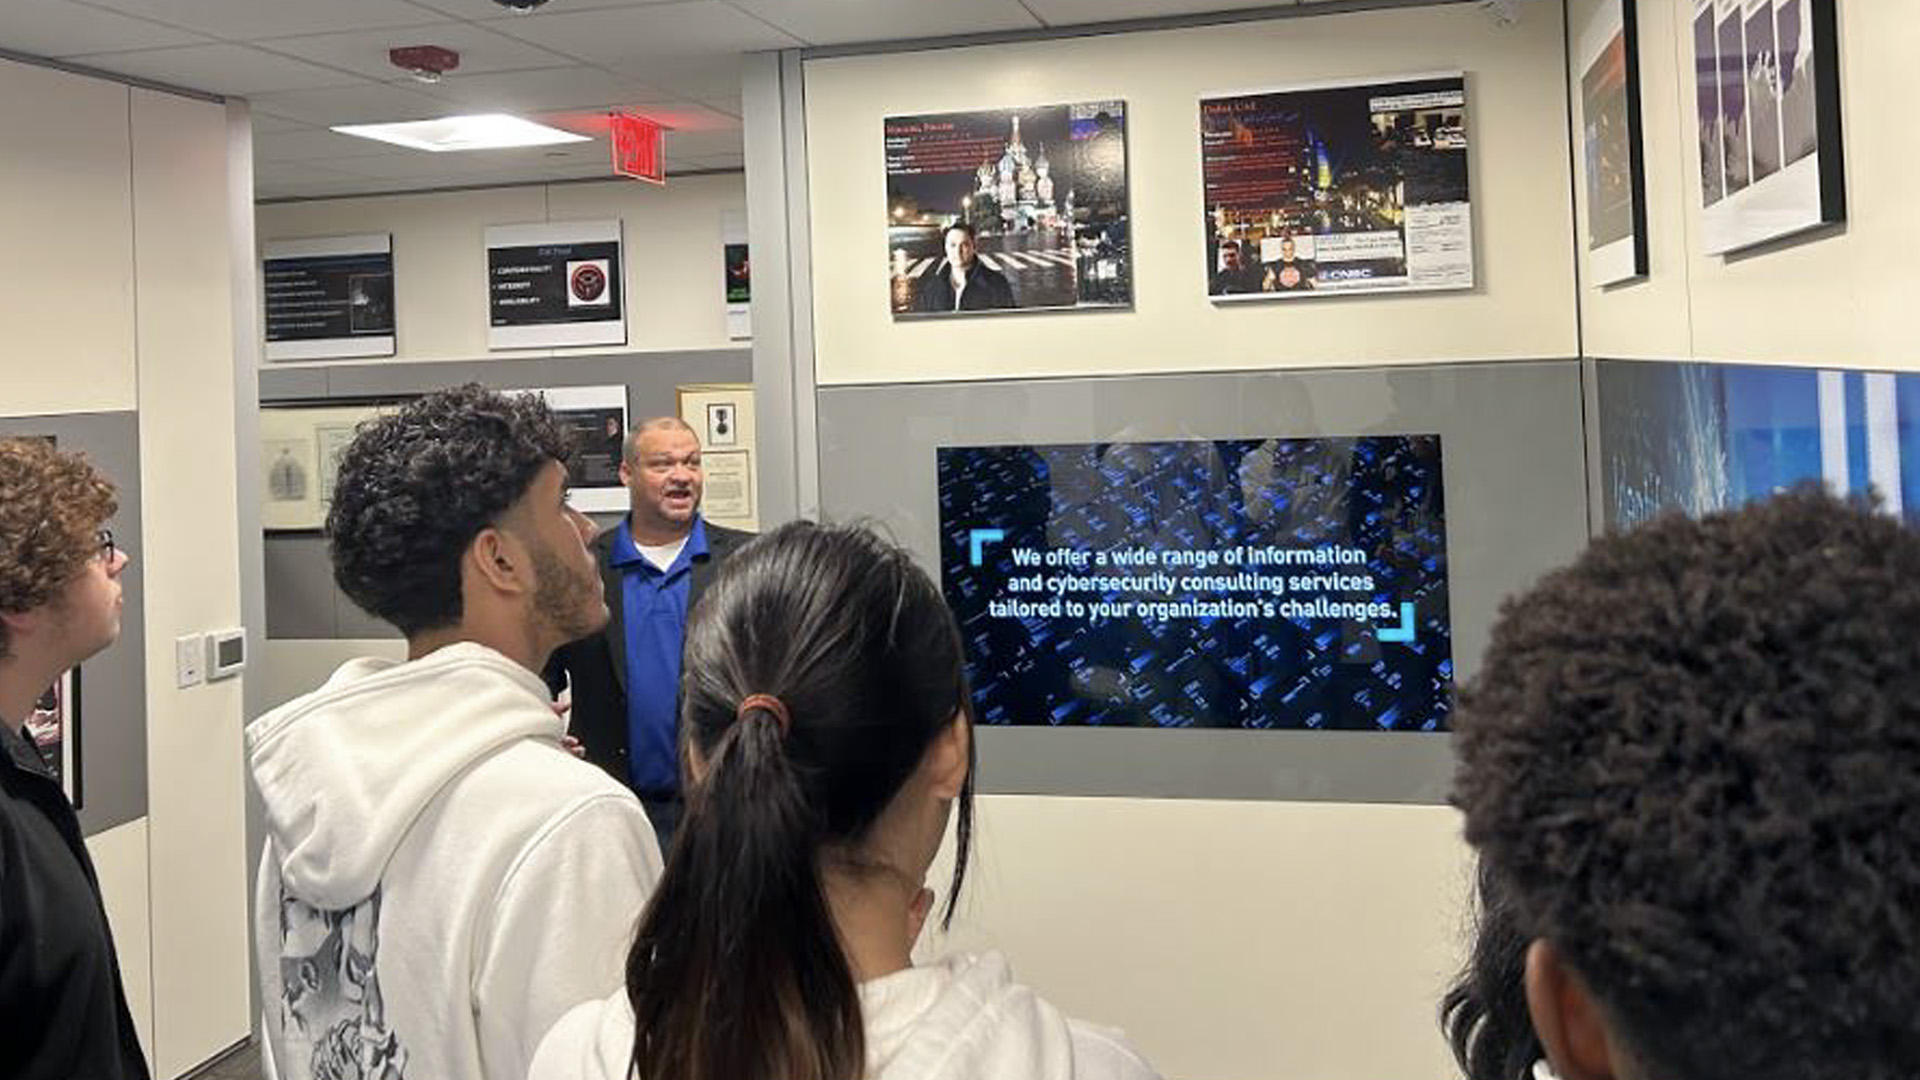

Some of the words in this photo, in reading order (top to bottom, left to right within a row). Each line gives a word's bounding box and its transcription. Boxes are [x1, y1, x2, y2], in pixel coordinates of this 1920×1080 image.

[1012, 548, 1041, 566] We
[1046, 548, 1091, 565] offer
[1095, 551, 1107, 565] a
[1111, 547, 1157, 565] wide
[1162, 550, 1219, 569] range
[1224, 546, 1244, 564] of
[1248, 545, 1366, 565] information
[1008, 573, 1042, 591] and
[1047, 572, 1176, 595] cybersecurity
[1181, 572, 1284, 595] consulting
[1289, 572, 1374, 591] services
[989, 598, 1061, 617] tailored
[1066, 600, 1084, 617] to
[1089, 601, 1132, 621] your
[1137, 598, 1275, 621] organization's
[1279, 597, 1398, 622] challenges.
